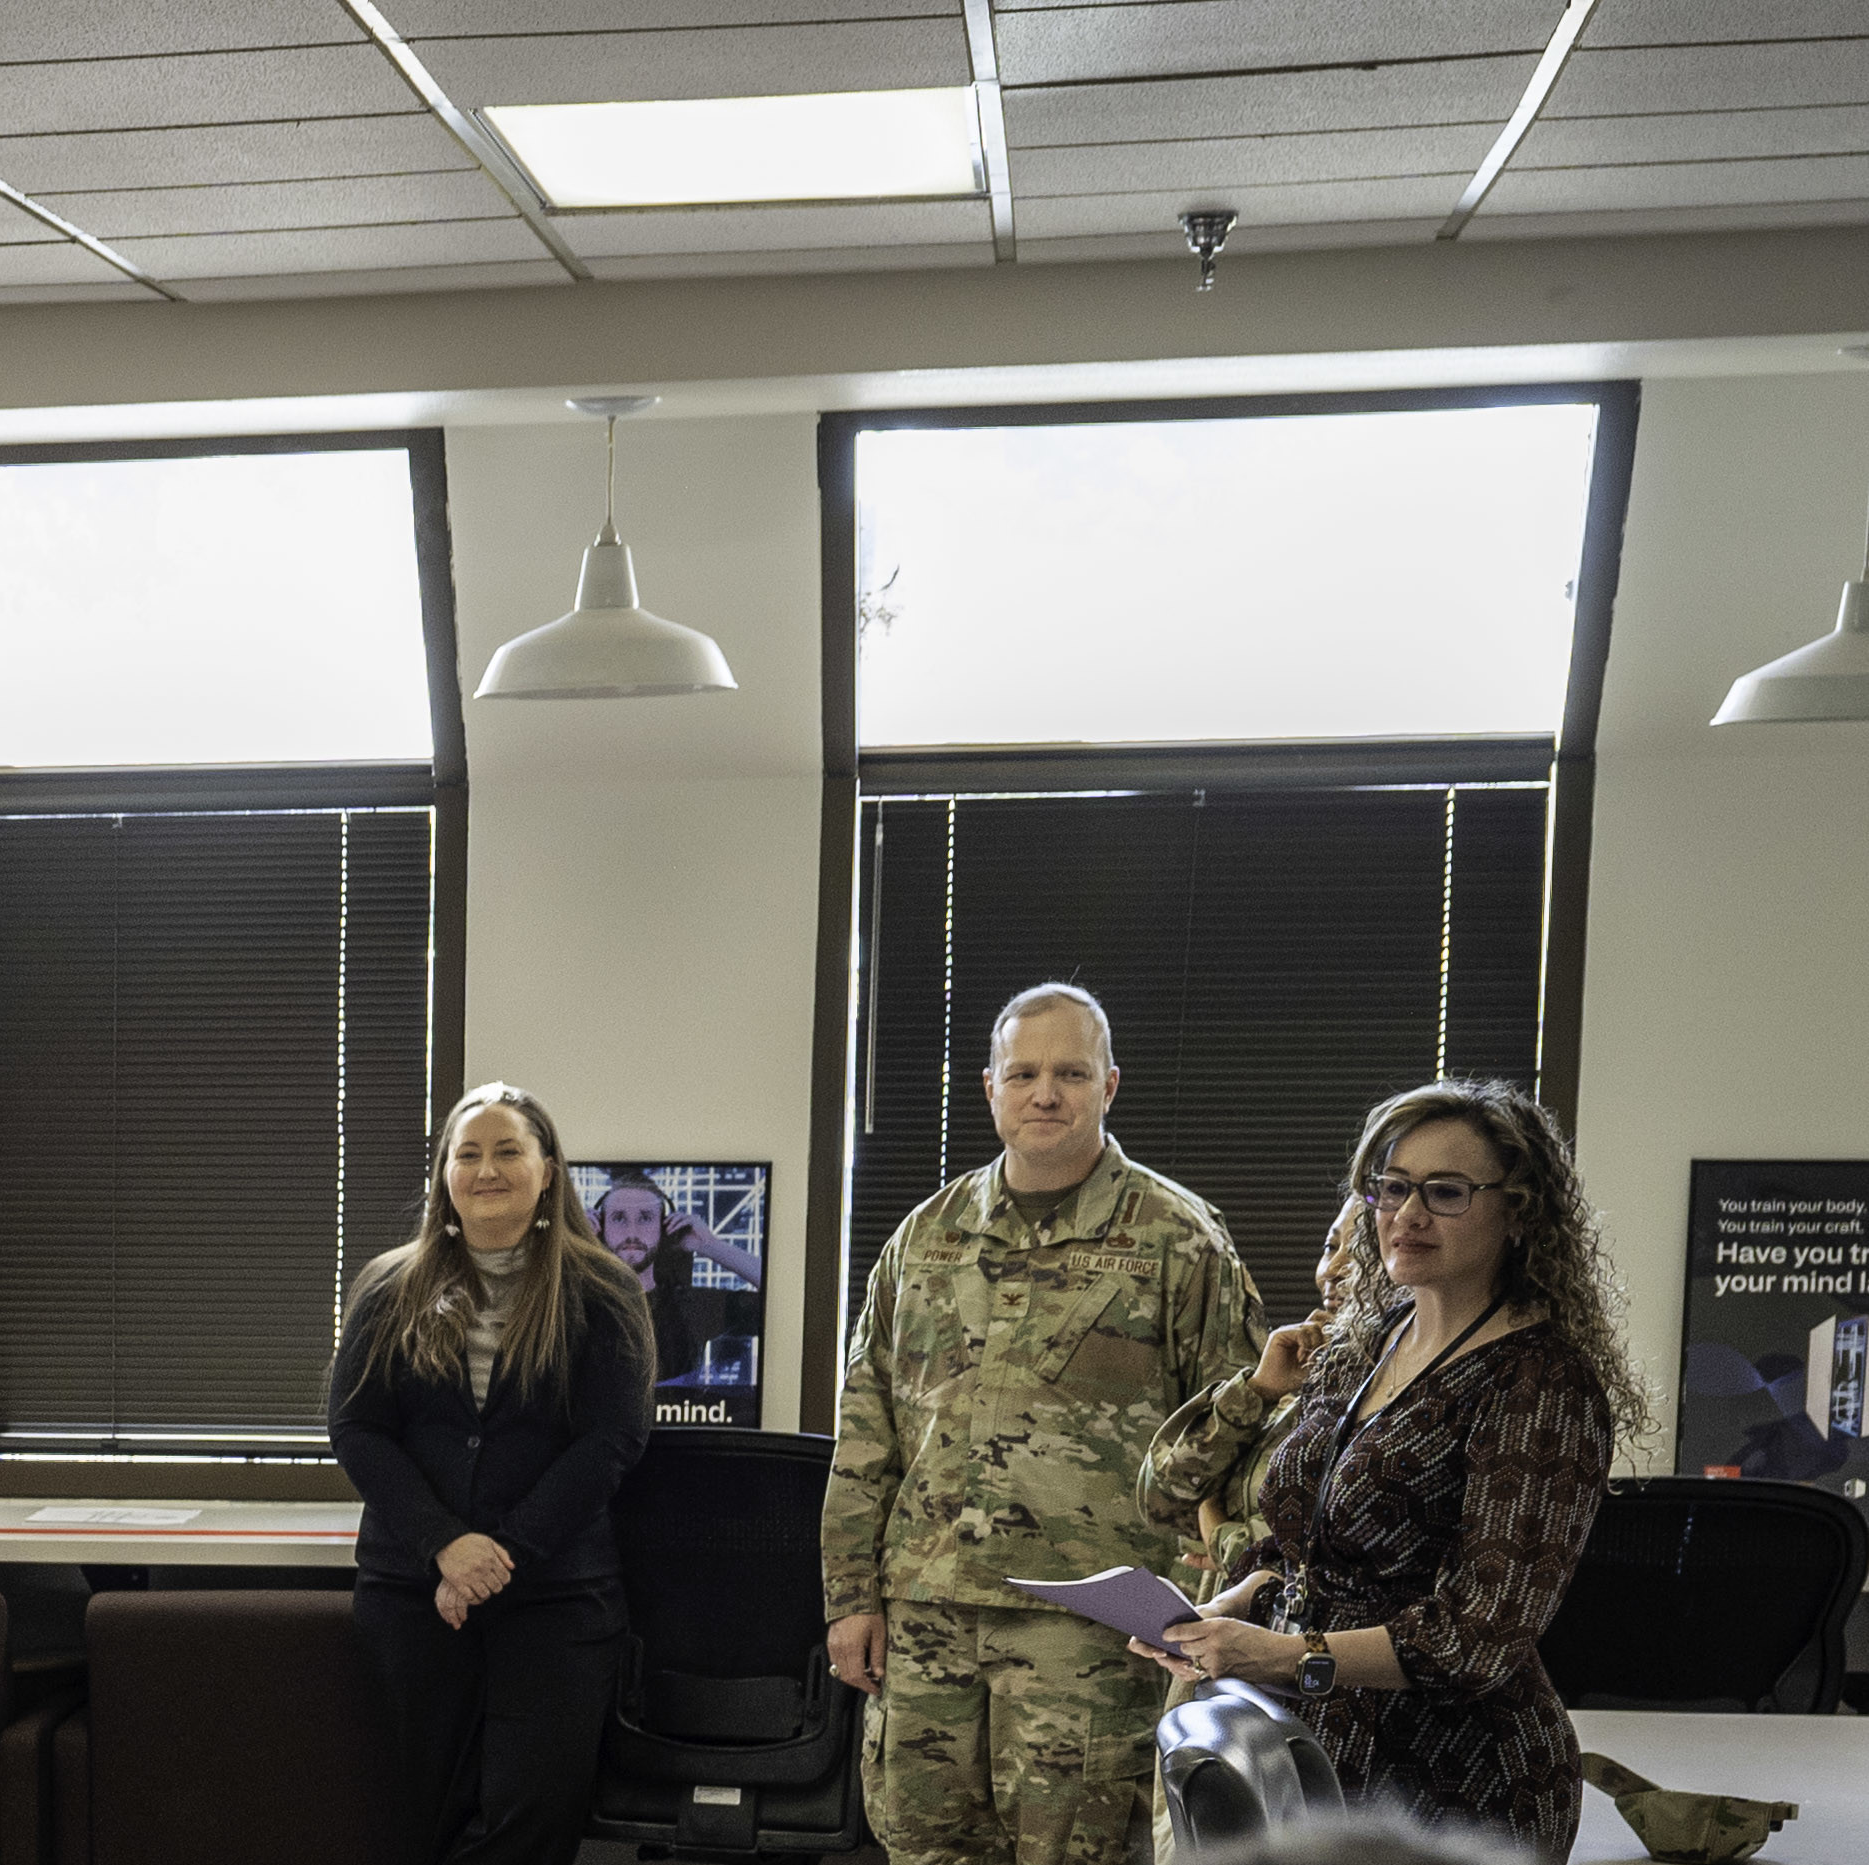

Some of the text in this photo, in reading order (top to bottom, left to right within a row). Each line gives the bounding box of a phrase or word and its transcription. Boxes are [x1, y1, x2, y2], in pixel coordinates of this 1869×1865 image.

[1719, 1198, 1867, 1217] You train your body.
[1718, 1218, 1864, 1237] You train your craft.
[923, 1250, 963, 1263] POWER
[1716, 1241, 1787, 1264] Have
[1794, 1247, 1843, 1269] you
[1094, 1257, 1116, 1271] AIR
[1118, 1258, 1160, 1275] FORCE
[1715, 1271, 1776, 1297] your
[1782, 1270, 1852, 1293] mind
[656, 1399, 733, 1423] mind.
